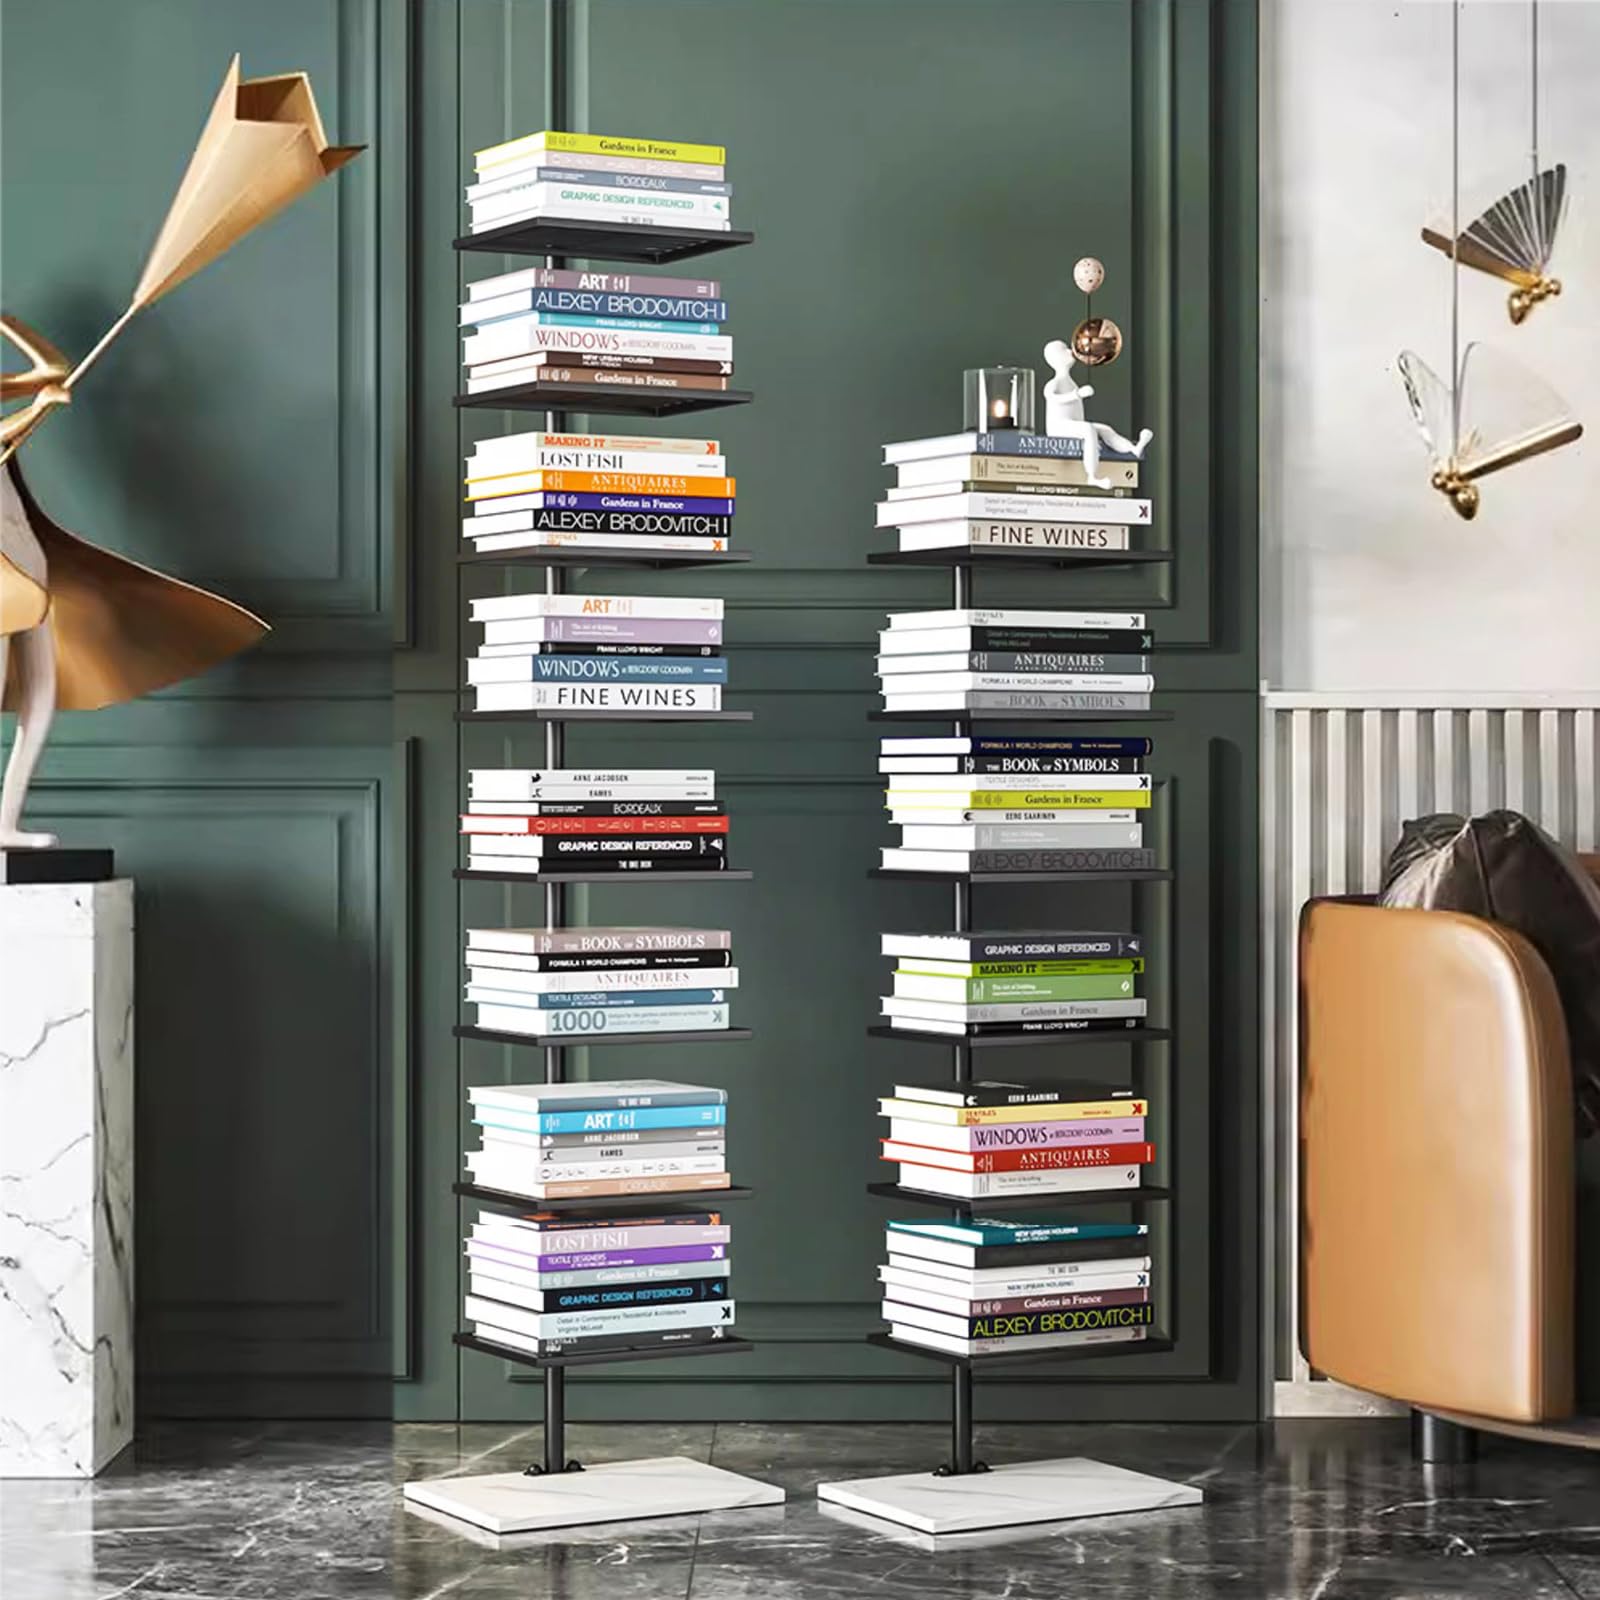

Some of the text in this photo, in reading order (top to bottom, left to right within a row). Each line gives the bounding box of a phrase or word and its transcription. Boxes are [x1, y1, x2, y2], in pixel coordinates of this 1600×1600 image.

[600, 140, 635, 153] Gardens
[648, 142, 677, 156] France
[616, 175, 667, 190] BORDEAUX
[561, 190, 694, 209] GRAPHIC DESIGN REFERENCED
[579, 274, 609, 290] ART
[536, 291, 717, 319] ALEXEY BRODOVITCH
[536, 330, 620, 350] WINDOWS
[594, 372, 678, 386] Gardens in France
[544, 436, 591, 447] MAKING
[594, 438, 605, 448] IT
[1019, 437, 1082, 450] ANTIQUAI
[540, 451, 623, 469] LOST FISH
[592, 474, 687, 488] ANTIQUAIRES
[601, 497, 684, 510] Gardens in France
[537, 512, 719, 533] ALEXEY BRODOVITCH
[990, 526, 1108, 547] FINE WINES
[582, 600, 611, 613] ART
[538, 660, 620, 677] WINDOWS
[1014, 654, 1104, 668] ANTIQUAIRES
[558, 688, 609, 705] FINE
[621, 689, 696, 706] WINES
[1009, 696, 1126, 707] BOOK SYMBOLS
[1002, 758, 1040, 771] BOOK
[1054, 758, 1119, 771] SYMBOLS
[1025, 794, 1061, 804] Gardens
[1074, 795, 1102, 804] France
[613, 803, 662, 814] BORDEAUX
[558, 840, 692, 851] GRAPHIC DESIGN REFERENCED
[974, 852, 1142, 869] ALEXEY BRODOVITCH
[581, 937, 621, 950] BOOK
[635, 935, 705, 949] SYMBOLS
[985, 943, 1111, 955] GRAPHIC DESIGN REFERENCED
[980, 964, 1023, 974] MAKING
[1026, 963, 1036, 973] IT
[596, 972, 690, 984] ANTIQUAIRES
[1021, 1005, 1098, 1016] Gardens in France
[552, 1010, 606, 1031] 1000
[584, 1114, 614, 1128] ART
[975, 1127, 1047, 1145] WINDOWS
[1020, 1149, 1110, 1164] ANTIQUAIRES
[545, 1231, 629, 1251] LOST FISH
[560, 1287, 693, 1305] GRAPHIC DESIGN REFERENCED
[1024, 1298, 1060, 1309] Gardens
[1073, 1295, 1102, 1304] France
[973, 1308, 1143, 1337] ALEXEY BRODOVITCH
